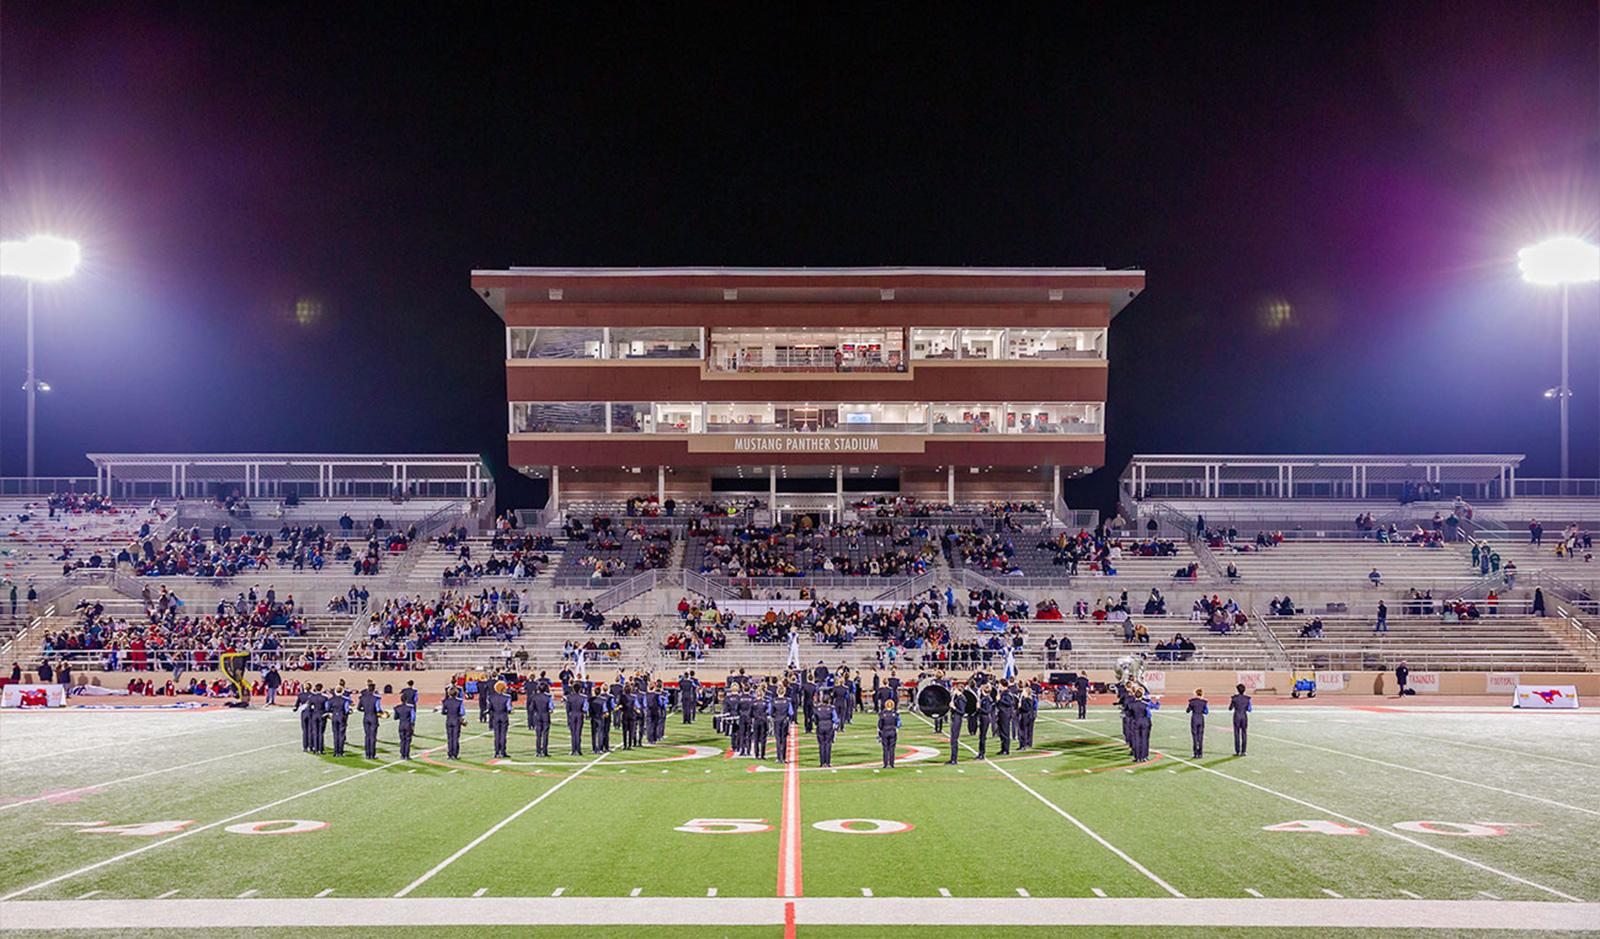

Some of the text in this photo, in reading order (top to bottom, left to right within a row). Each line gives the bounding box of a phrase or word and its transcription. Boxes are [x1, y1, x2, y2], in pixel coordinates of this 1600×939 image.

[735, 438, 879, 450] MUSTANG PANTHER STADIUM
